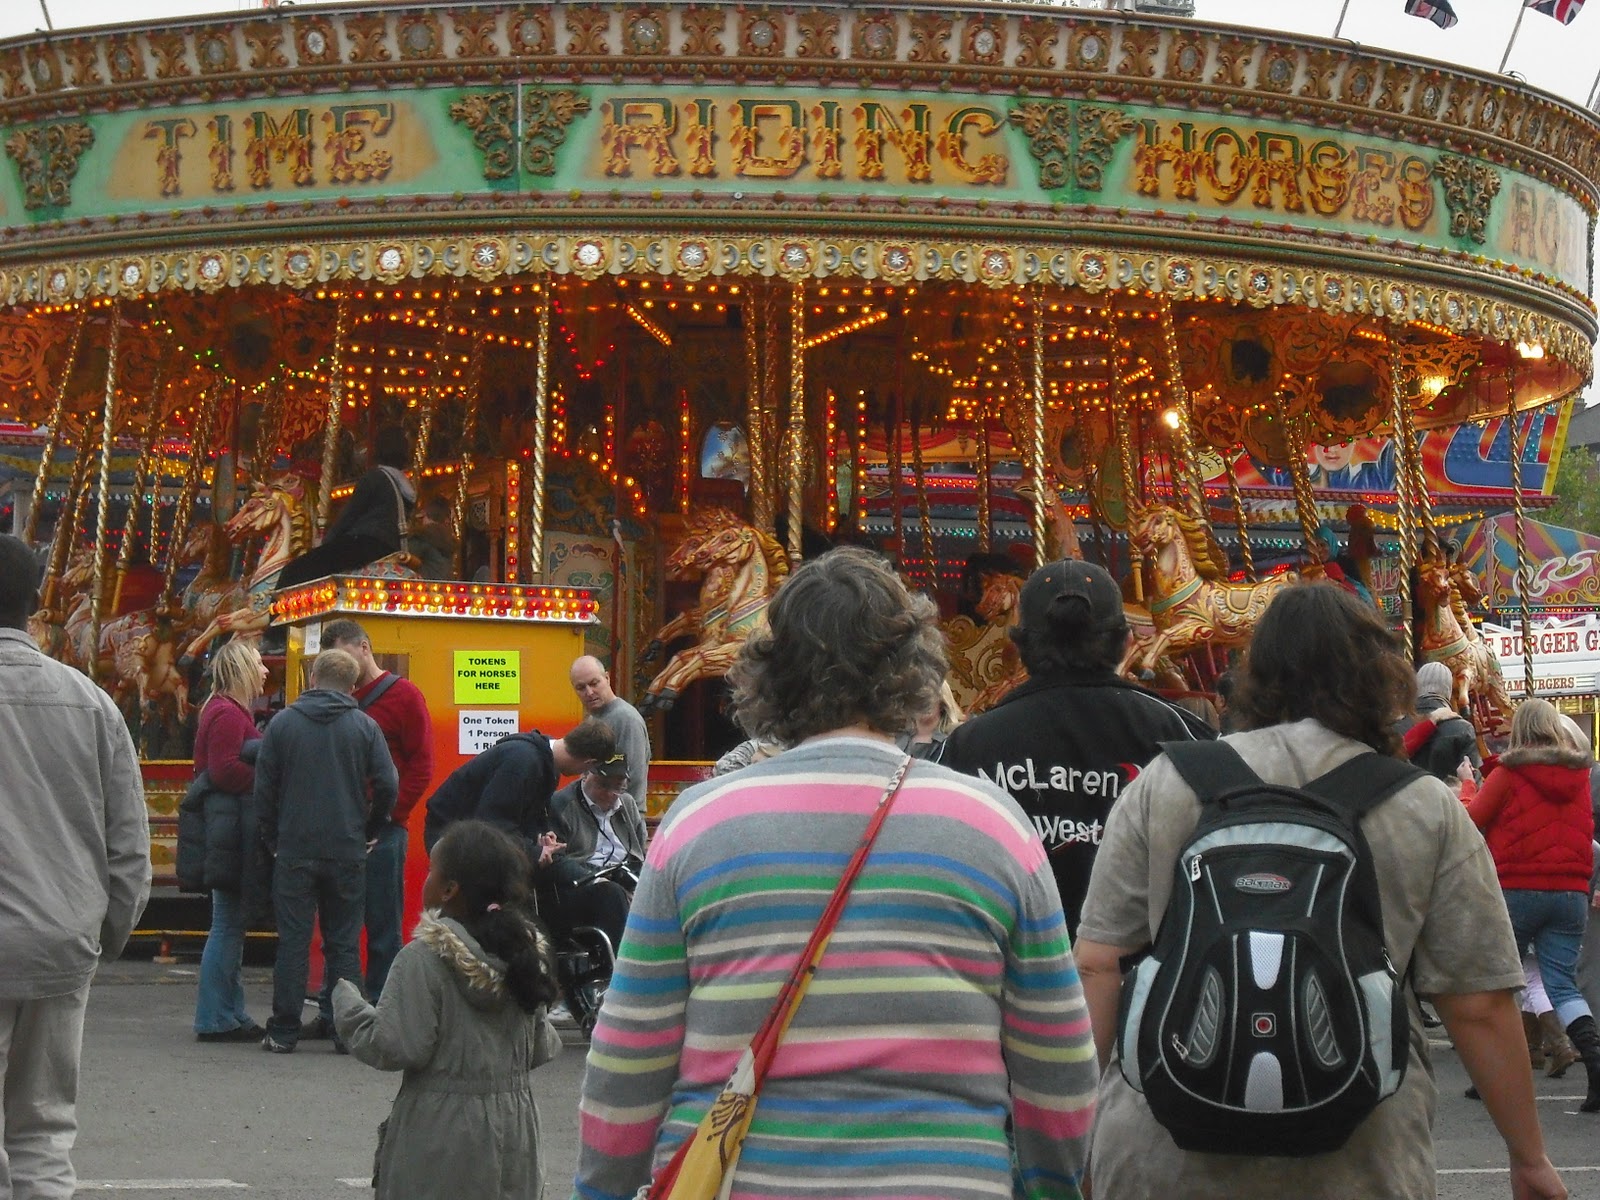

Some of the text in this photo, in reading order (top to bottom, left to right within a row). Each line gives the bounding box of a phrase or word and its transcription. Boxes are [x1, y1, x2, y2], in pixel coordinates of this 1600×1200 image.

[143, 97, 1435, 230] TIME RIDING HORSES
[1500, 632, 1580, 657] BURGER
[468, 658, 506, 666] TOKENS
[457, 670, 517, 678] FOR HORSES
[475, 682, 501, 690] HERE
[1503, 677, 1575, 692] AMURGERS
[463, 716, 515, 725] One Token
[476, 730, 510, 738] Person
[482, 742, 497, 750] Ri
[978, 758, 1119, 798] McLaren
[1033, 816, 1104, 846] West
